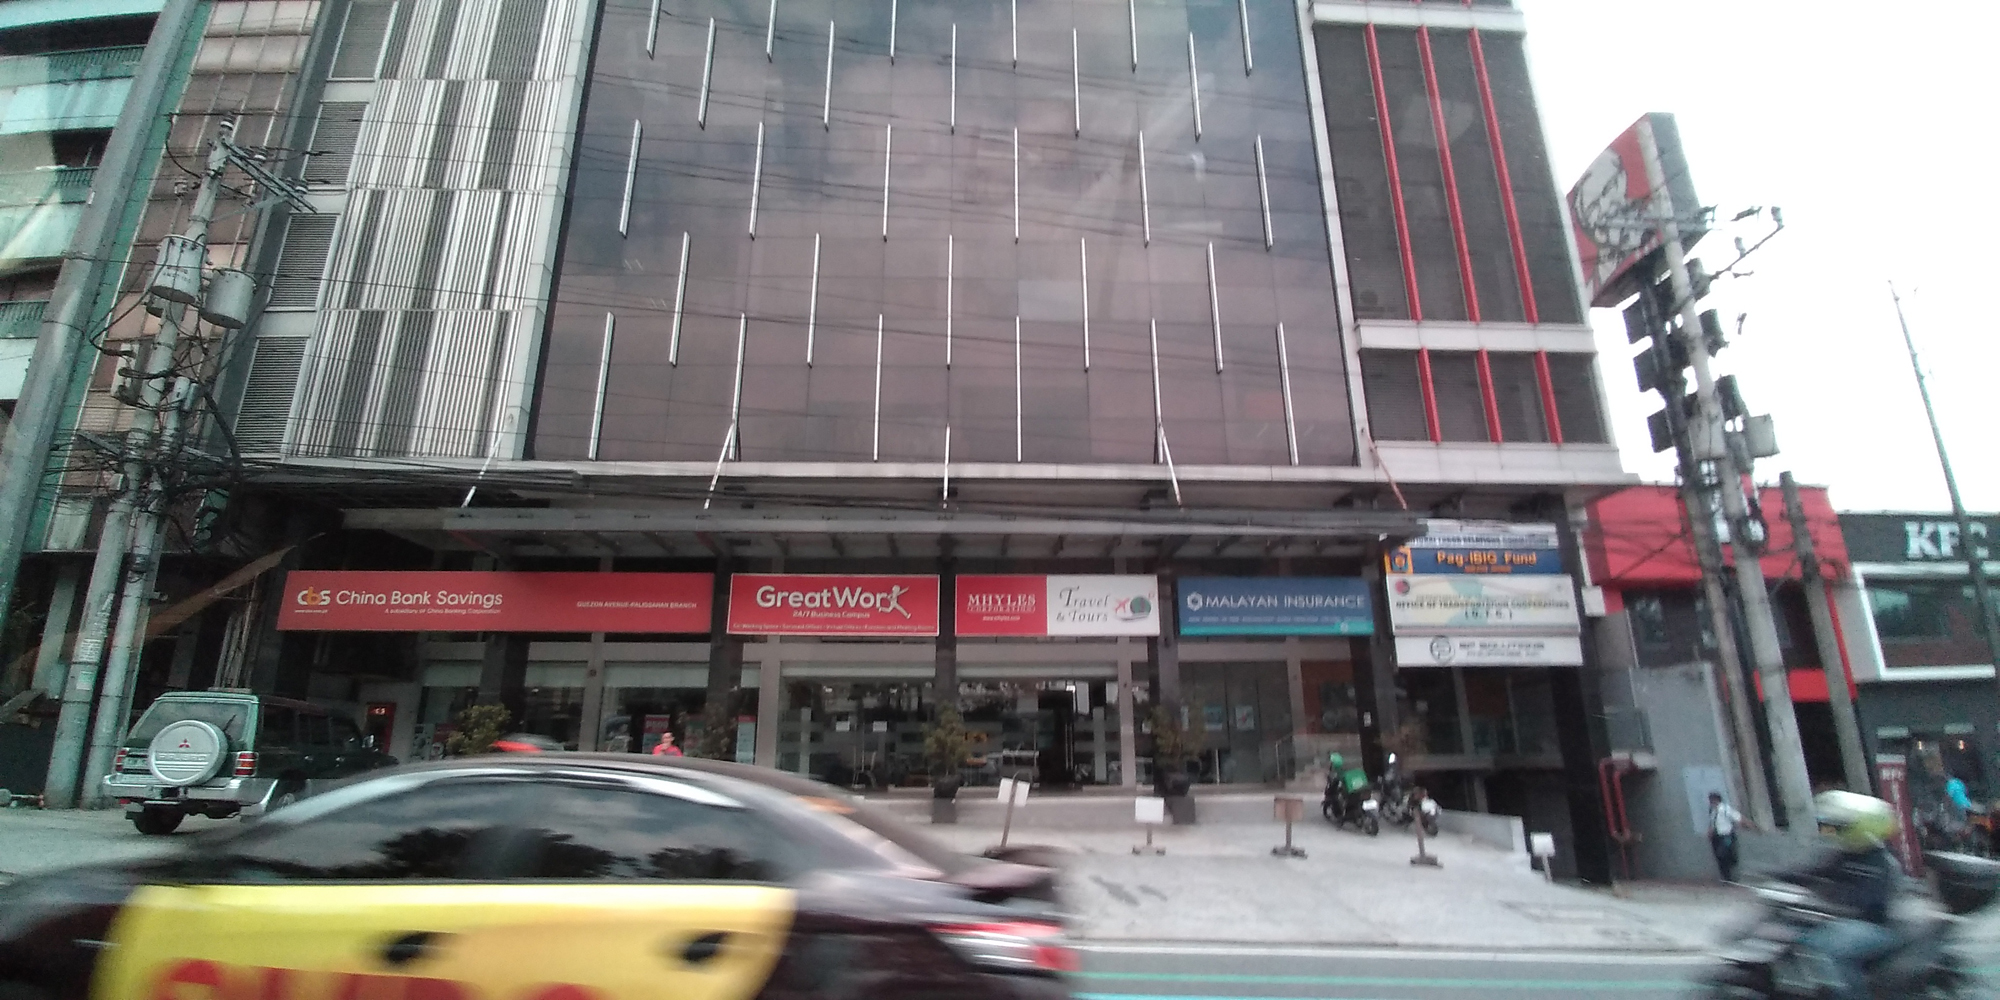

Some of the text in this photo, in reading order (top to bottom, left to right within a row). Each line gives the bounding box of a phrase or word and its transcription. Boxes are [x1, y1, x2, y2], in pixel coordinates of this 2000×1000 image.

[1437, 550, 1537, 567] Pag-IBIG Fund
[336, 590, 386, 605] China
[390, 590, 431, 605] Bank
[436, 590, 503, 608] Savings
[967, 593, 1037, 606] MHYLES
[1059, 586, 1109, 608] Travel
[1205, 595, 1365, 608] MALAYAN INSURANCE
[793, 610, 870, 620] 24/7 Business Campus
[1056, 610, 1109, 622] & Tours
